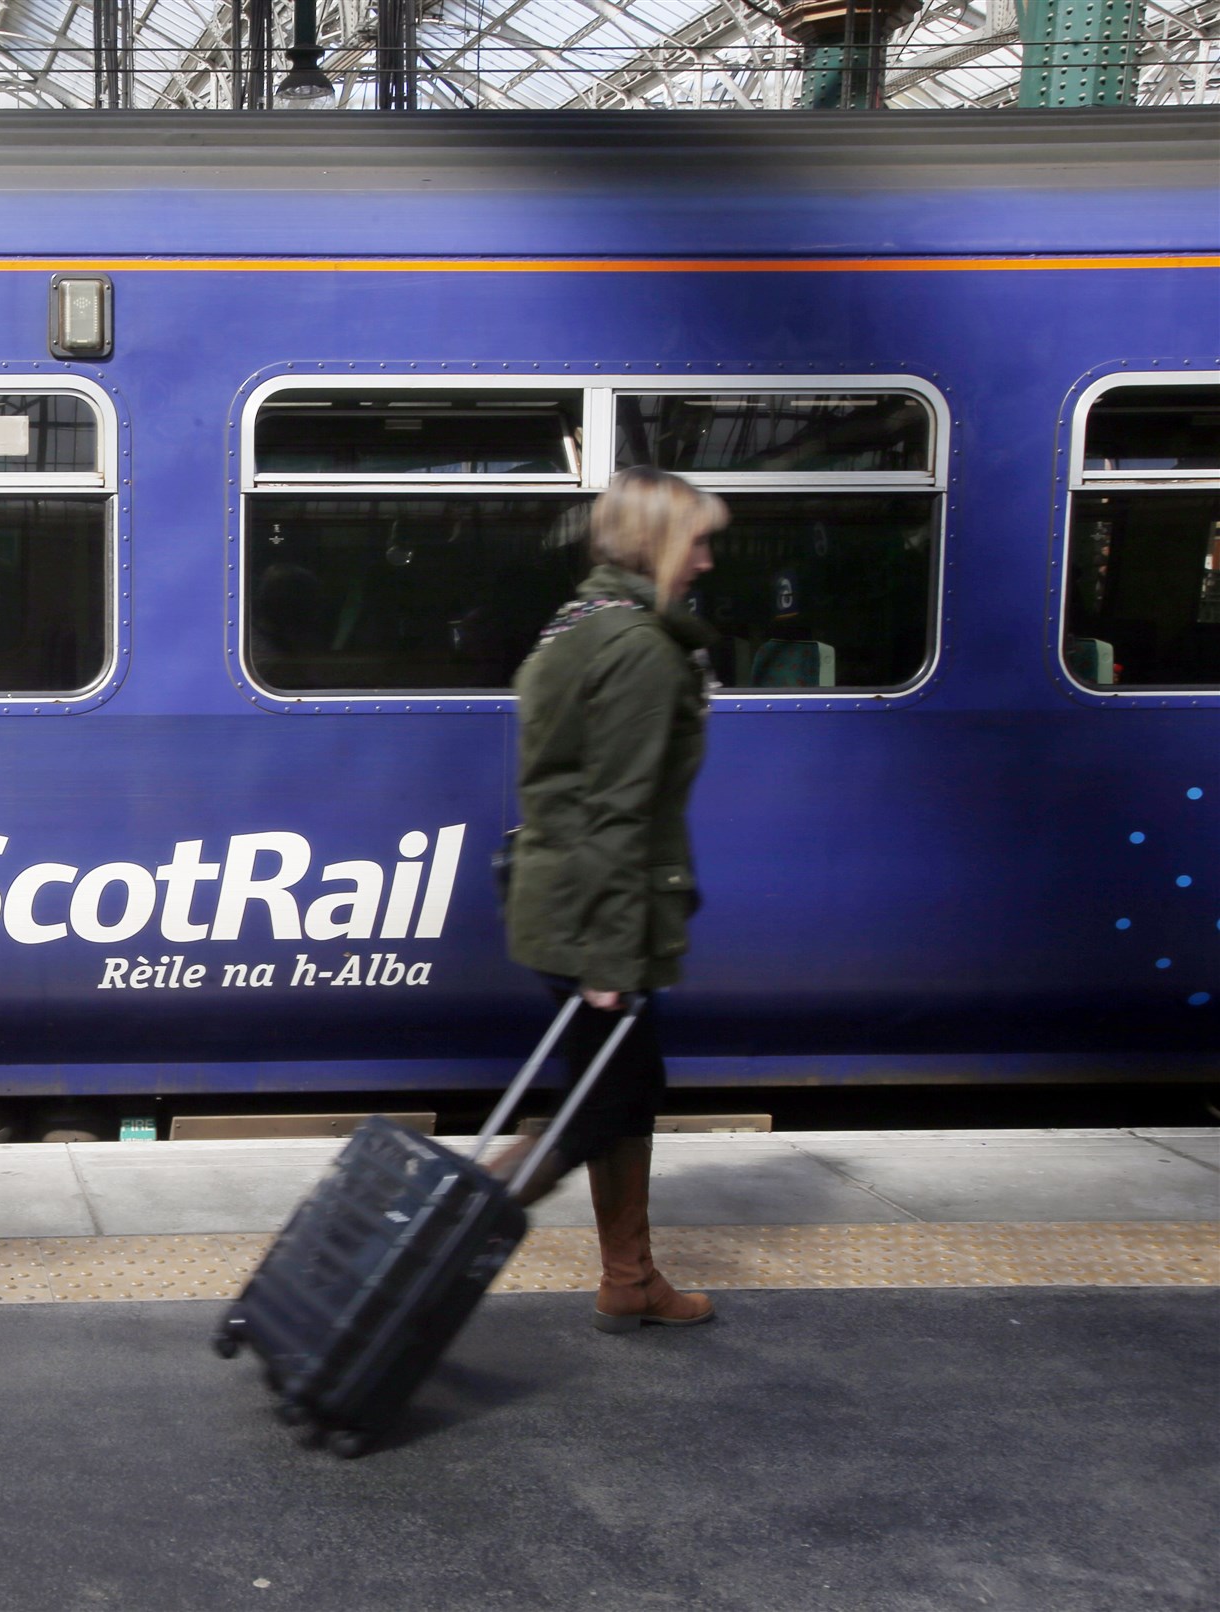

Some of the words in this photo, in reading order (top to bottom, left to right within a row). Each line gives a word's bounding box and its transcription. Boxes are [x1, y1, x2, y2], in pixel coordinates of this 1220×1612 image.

[97, 955, 207, 989] Rèile
[221, 963, 276, 988] na
[290, 954, 433, 988] h-Alba
